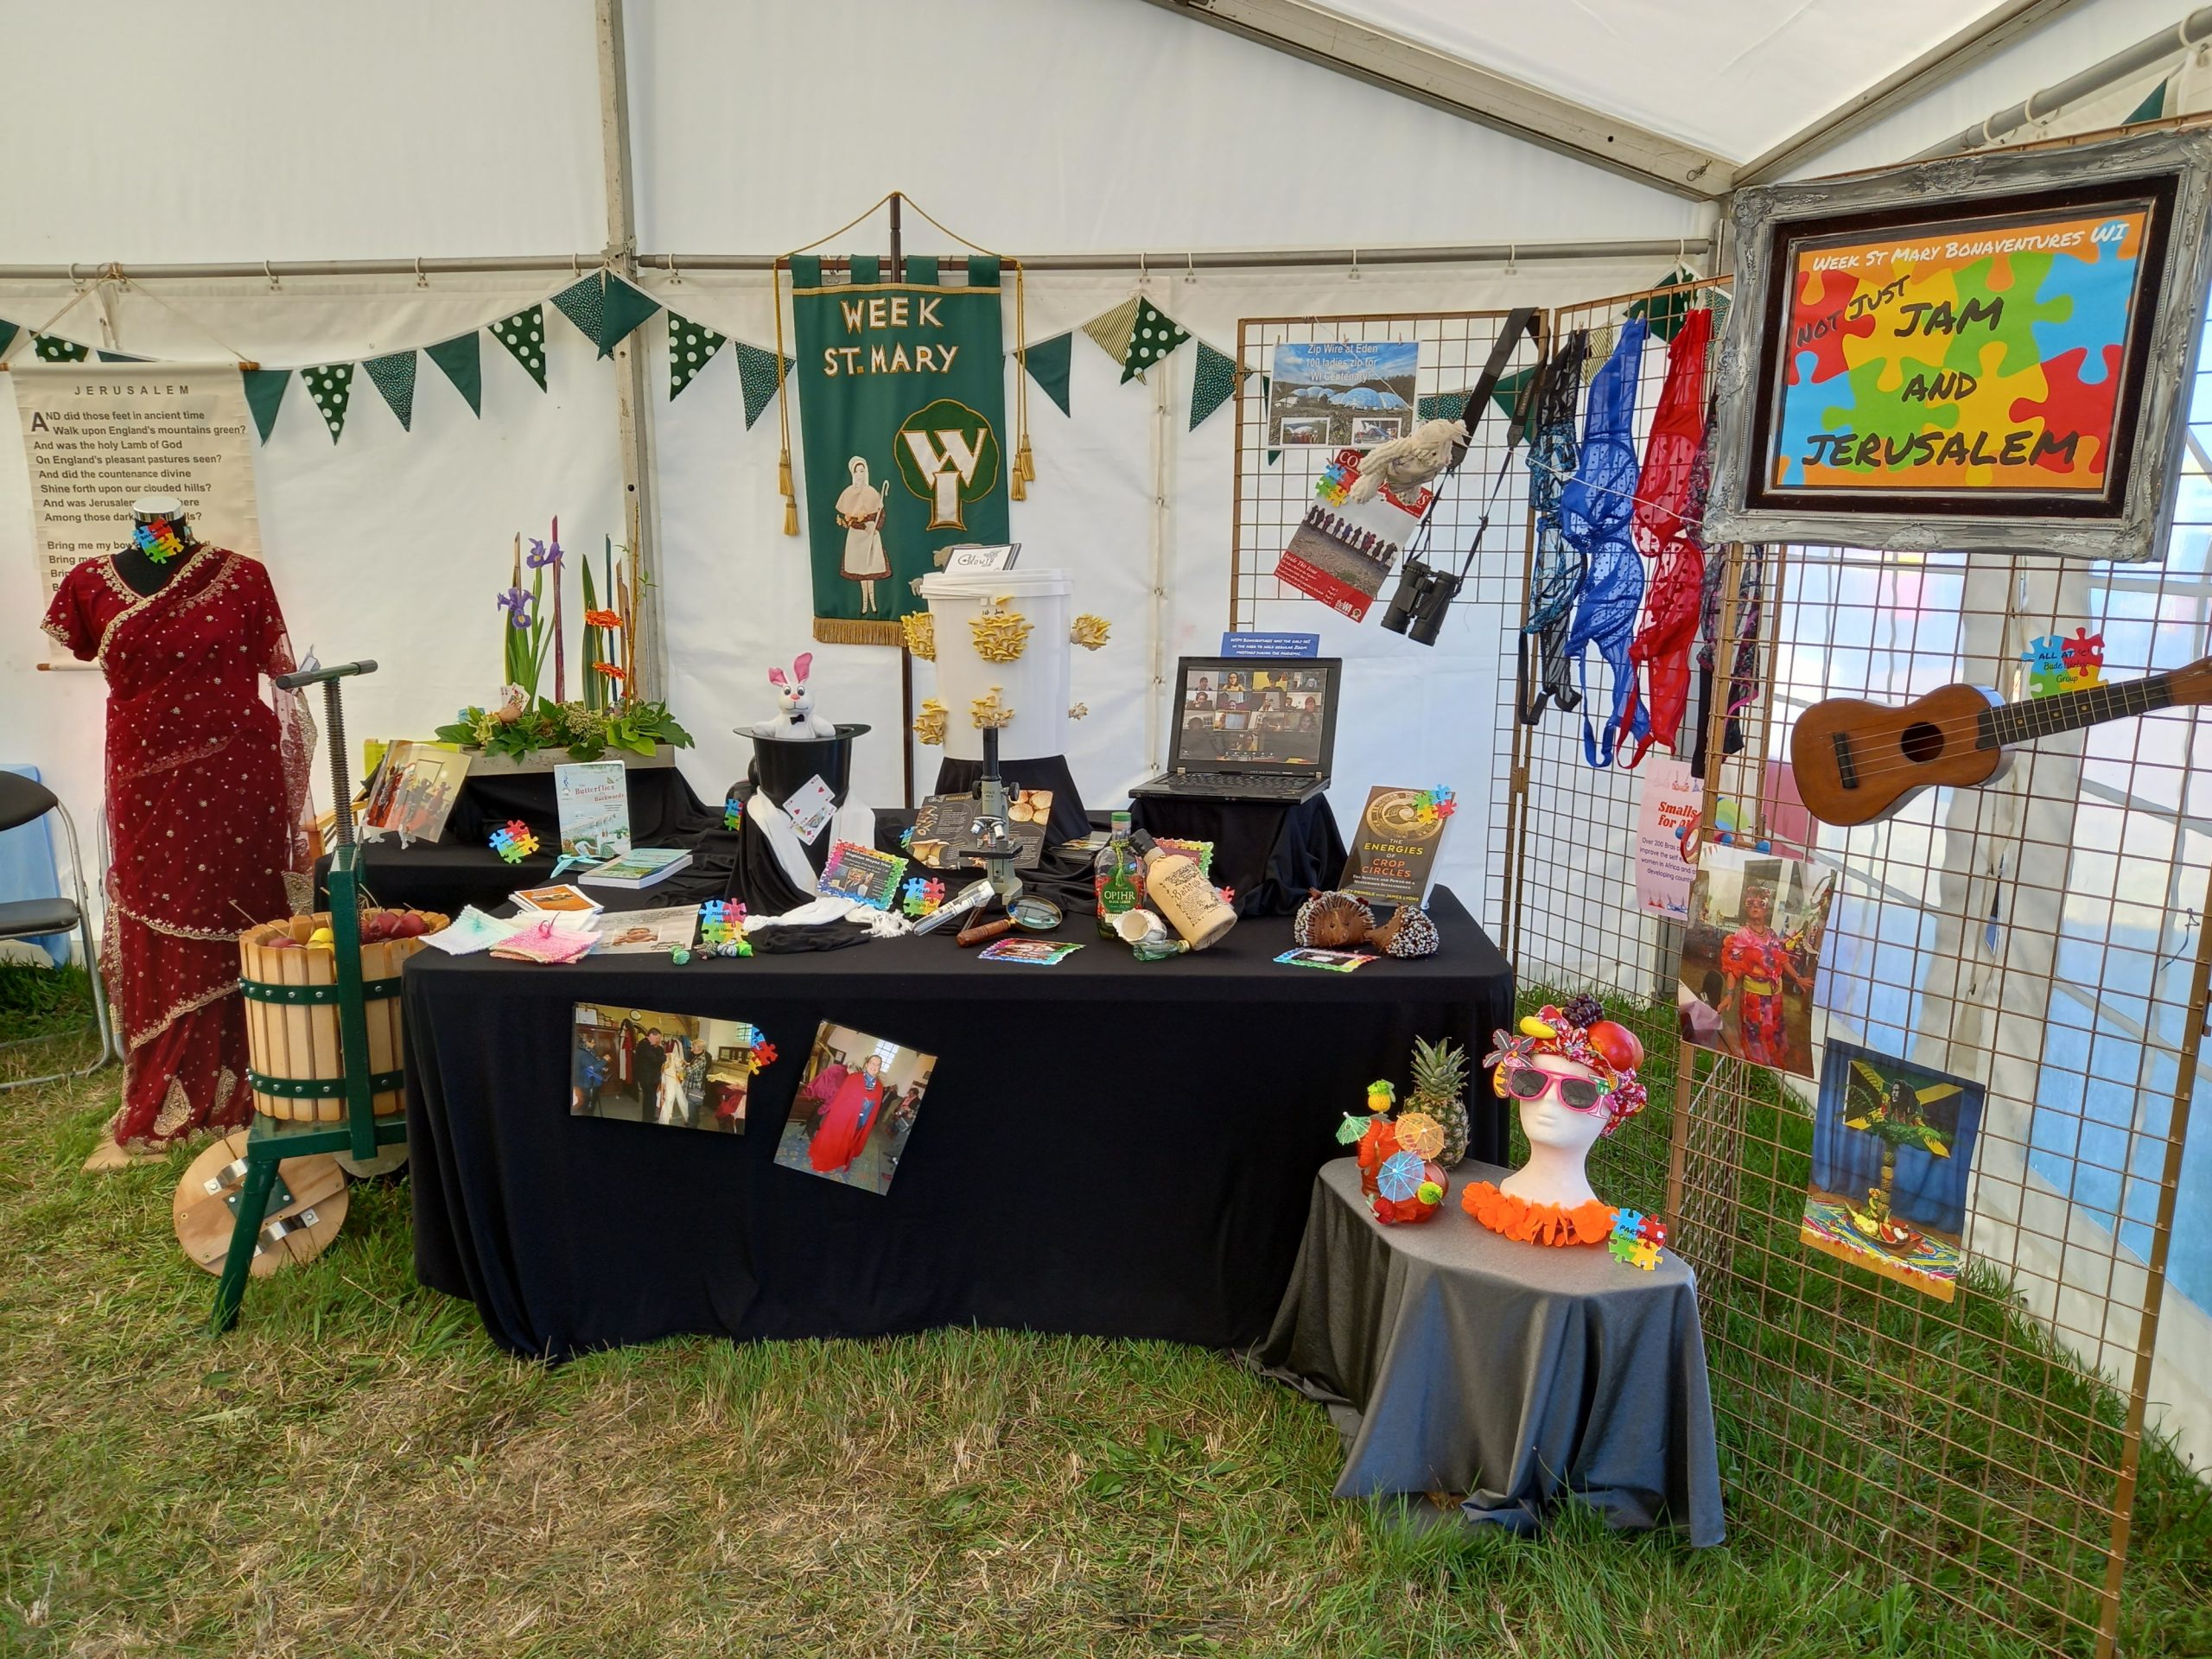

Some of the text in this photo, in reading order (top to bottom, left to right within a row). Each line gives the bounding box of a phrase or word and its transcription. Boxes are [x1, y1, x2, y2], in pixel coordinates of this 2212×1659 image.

[2091, 223, 2129, 243] WI
[841, 297, 944, 334] WEEK
[1796, 275, 1911, 347] NOT JUST
[1894, 297, 2004, 338] JAM
[1308, 344, 1321, 354] Zip
[1324, 344, 1342, 353] Wire
[1357, 344, 1377, 353] Eden
[871, 342, 959, 374] MARY
[1322, 358, 1348, 367] ladies
[1350, 359, 1363, 369] zip
[1365, 358, 1376, 367] for
[1311, 372, 1321, 381] WI
[74, 385, 189, 396] JERUSALEM
[1901, 372, 1977, 403] AND
[64, 411, 80, 420] did
[83, 411, 110, 420] those
[112, 411, 131, 420] feet
[133, 411, 142, 420] in
[144, 411, 181, 420] ancient
[183, 411, 204, 420] time
[54, 425, 246, 436] Walk upon England's mountains green?
[34, 441, 54, 450] And
[79, 441, 95, 449] the
[99, 441, 118, 451] holy
[121, 441, 147, 449] Lamb
[150, 441, 159, 449] of
[162, 441, 182, 449] God
[1802, 431, 2079, 467] JERUSALEM
[54, 455, 102, 466] England's
[105, 454, 145, 465] pleasant
[148, 454, 190, 465] pastures
[193, 454, 221, 463] seen?
[39, 470, 59, 479] And
[62, 470, 78, 479] did
[900, 428, 988, 531] WI
[73, 484, 95, 493] forth
[99, 486, 123, 494] upon
[184, 483, 211, 492] hills?
[43, 499, 65, 507] And
[45, 513, 81, 523] Among
[84, 513, 111, 522] those
[48, 541, 74, 550] Bring
[96, 543, 111, 551] my
[49, 556, 75, 564] Bring
[2056, 675, 2078, 683] Group
[1658, 802, 1697, 817] Smalls
[1658, 815, 1676, 828] for
[1364, 843, 1423, 855] ENERGIES
[1640, 847, 1659, 855] improve
[1373, 858, 1405, 868] CROP
[1362, 866, 1411, 877] CIRCLES
[1647, 868, 1674, 880] developing
[1104, 891, 1135, 899] OPIHR
